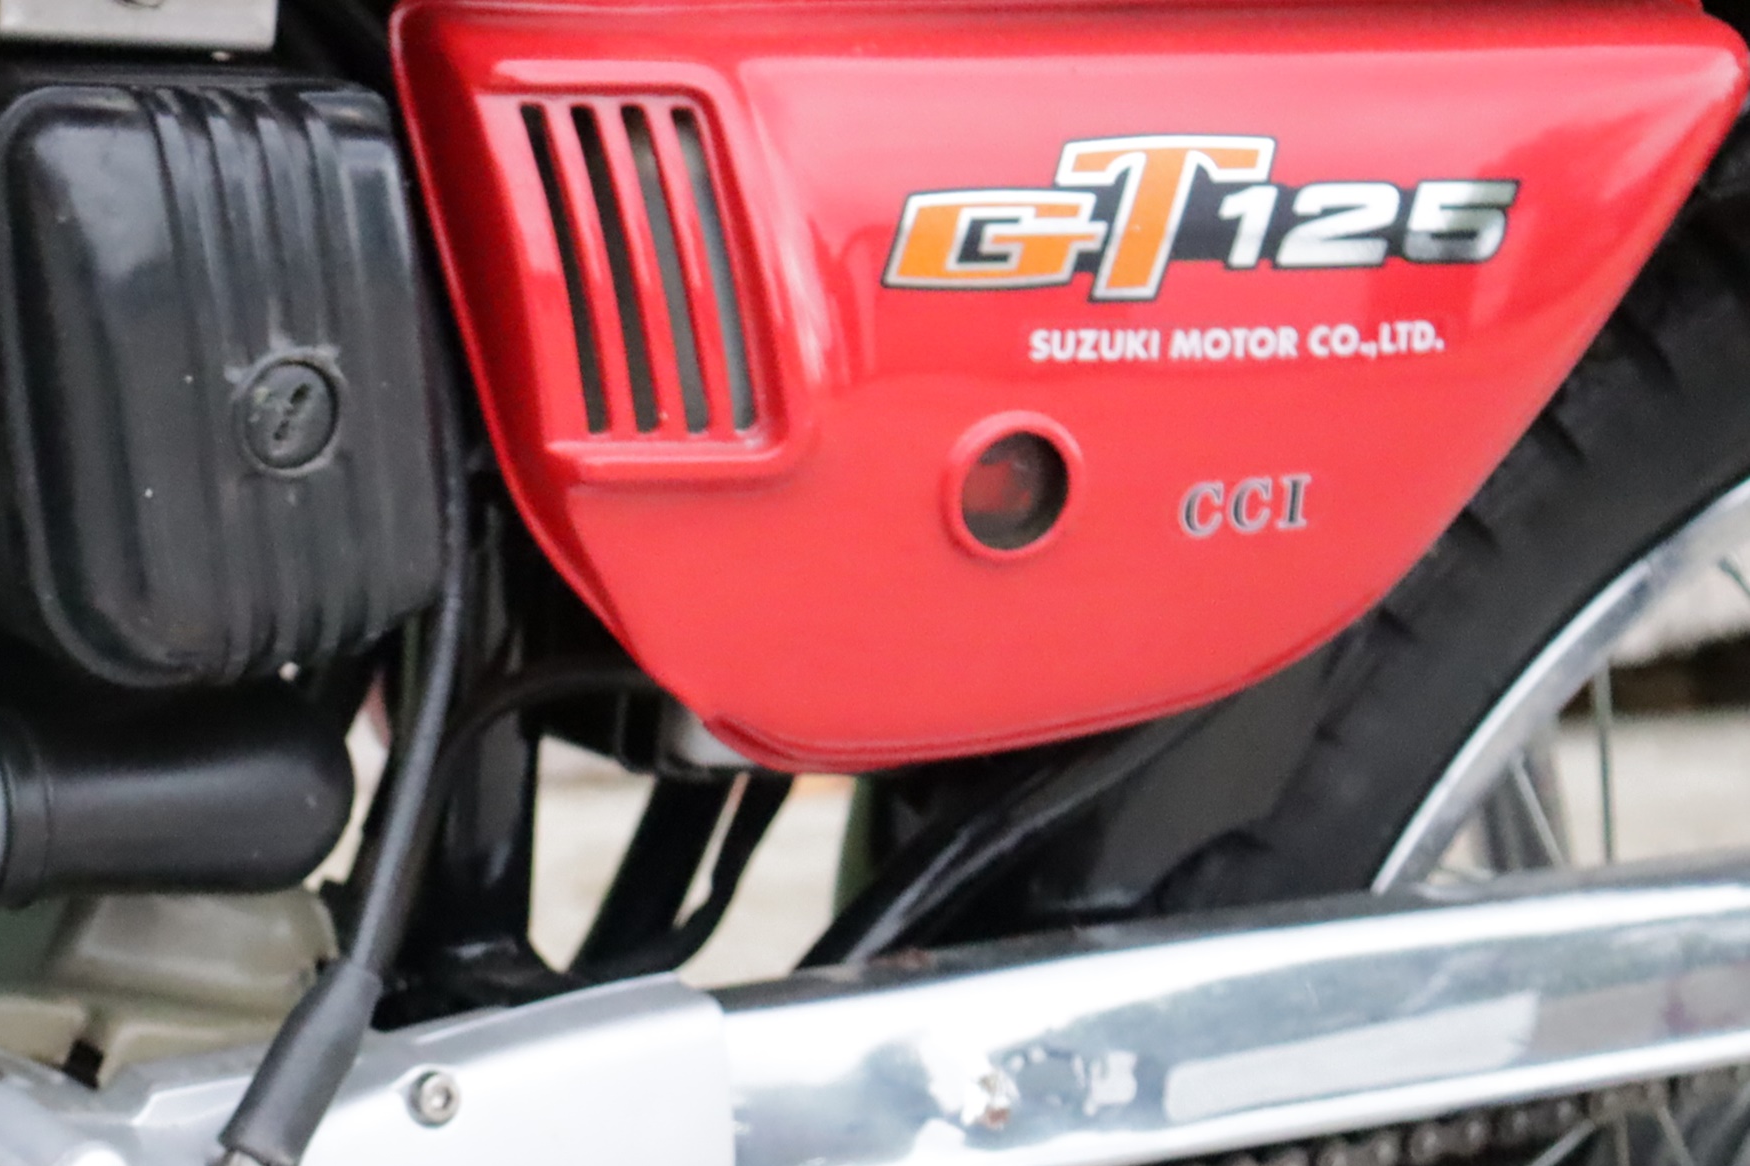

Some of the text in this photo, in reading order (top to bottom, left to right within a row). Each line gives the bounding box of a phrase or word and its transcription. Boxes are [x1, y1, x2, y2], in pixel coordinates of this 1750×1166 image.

[1028, 328, 1160, 362] SUZUKI
[1169, 326, 1298, 360] MOTOR
[1179, 474, 1312, 538] CCI
